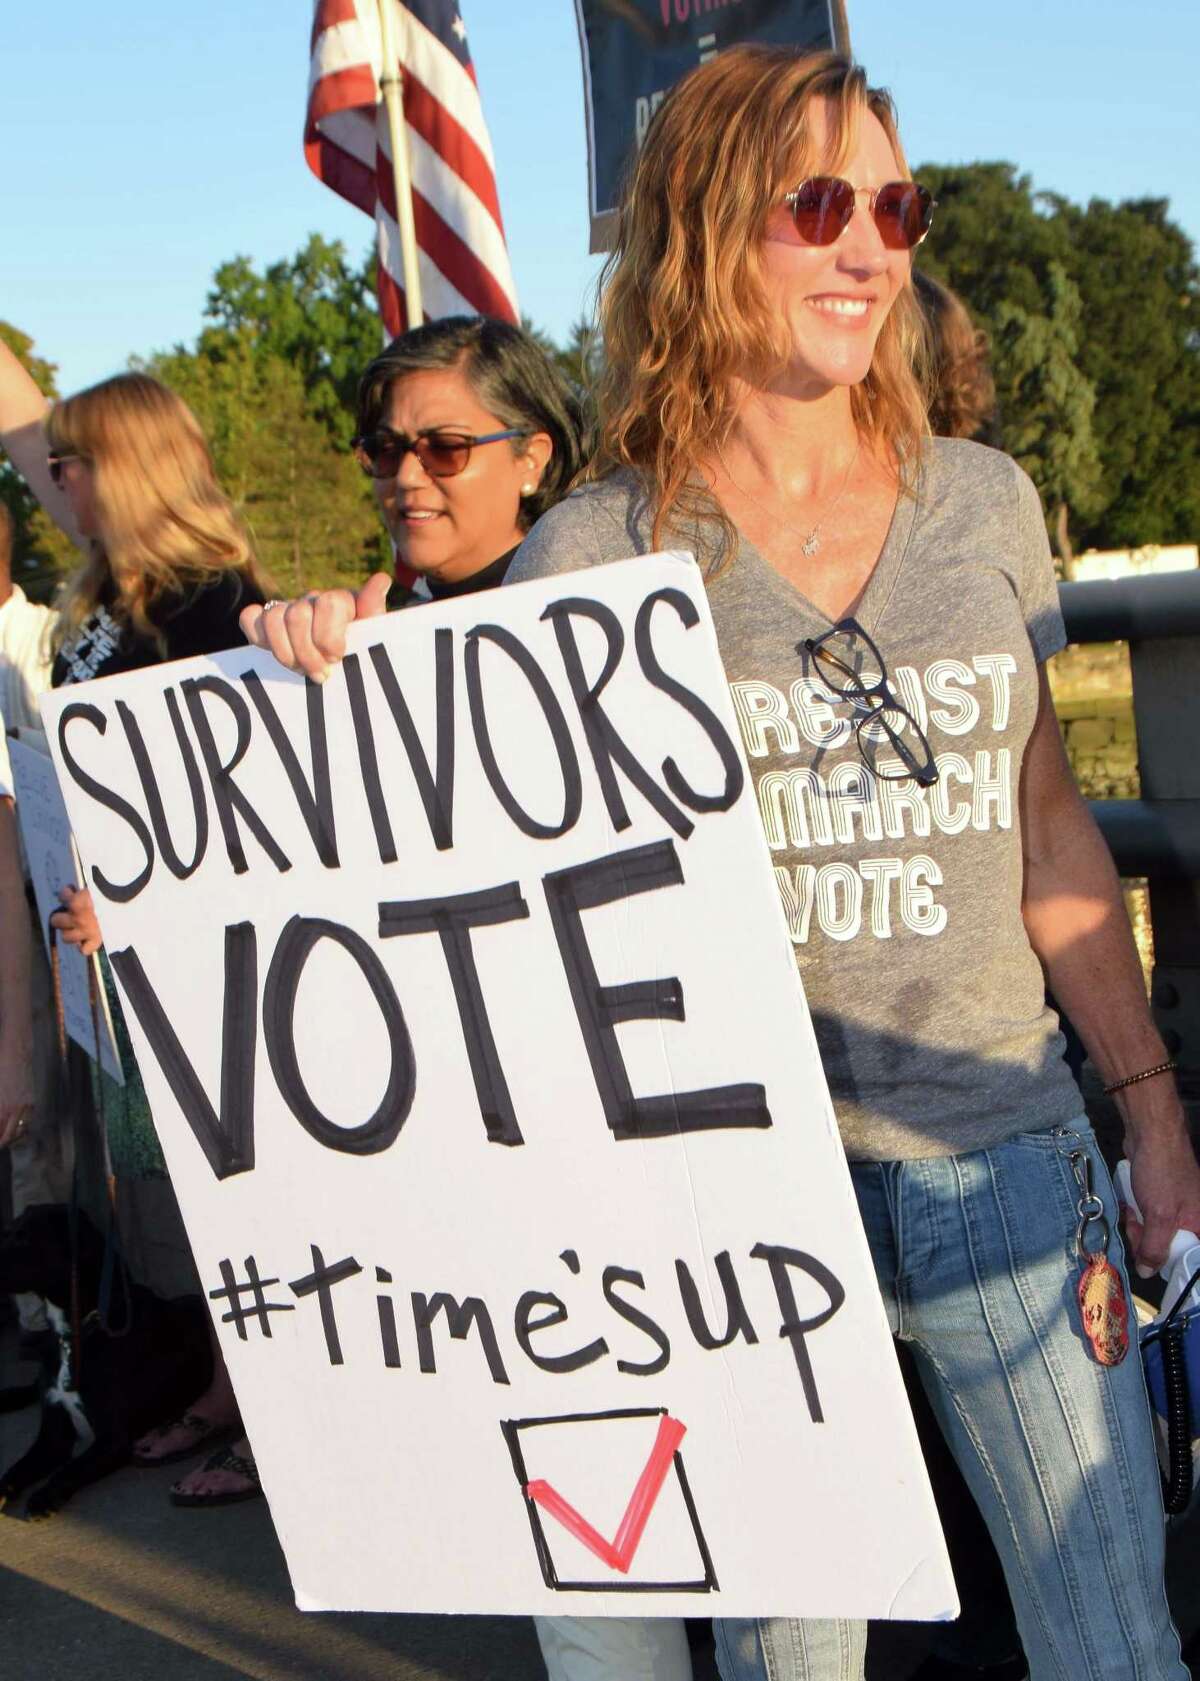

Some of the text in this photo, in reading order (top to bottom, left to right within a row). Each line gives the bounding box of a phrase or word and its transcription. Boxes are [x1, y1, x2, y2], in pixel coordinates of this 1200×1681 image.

[58, 588, 743, 904] SURVIVORS
[730, 653, 1018, 757] RESIST
[759, 748, 1012, 850] MARCH
[773, 854, 948, 944] VOTE
[109, 839, 773, 1181] VOTE
